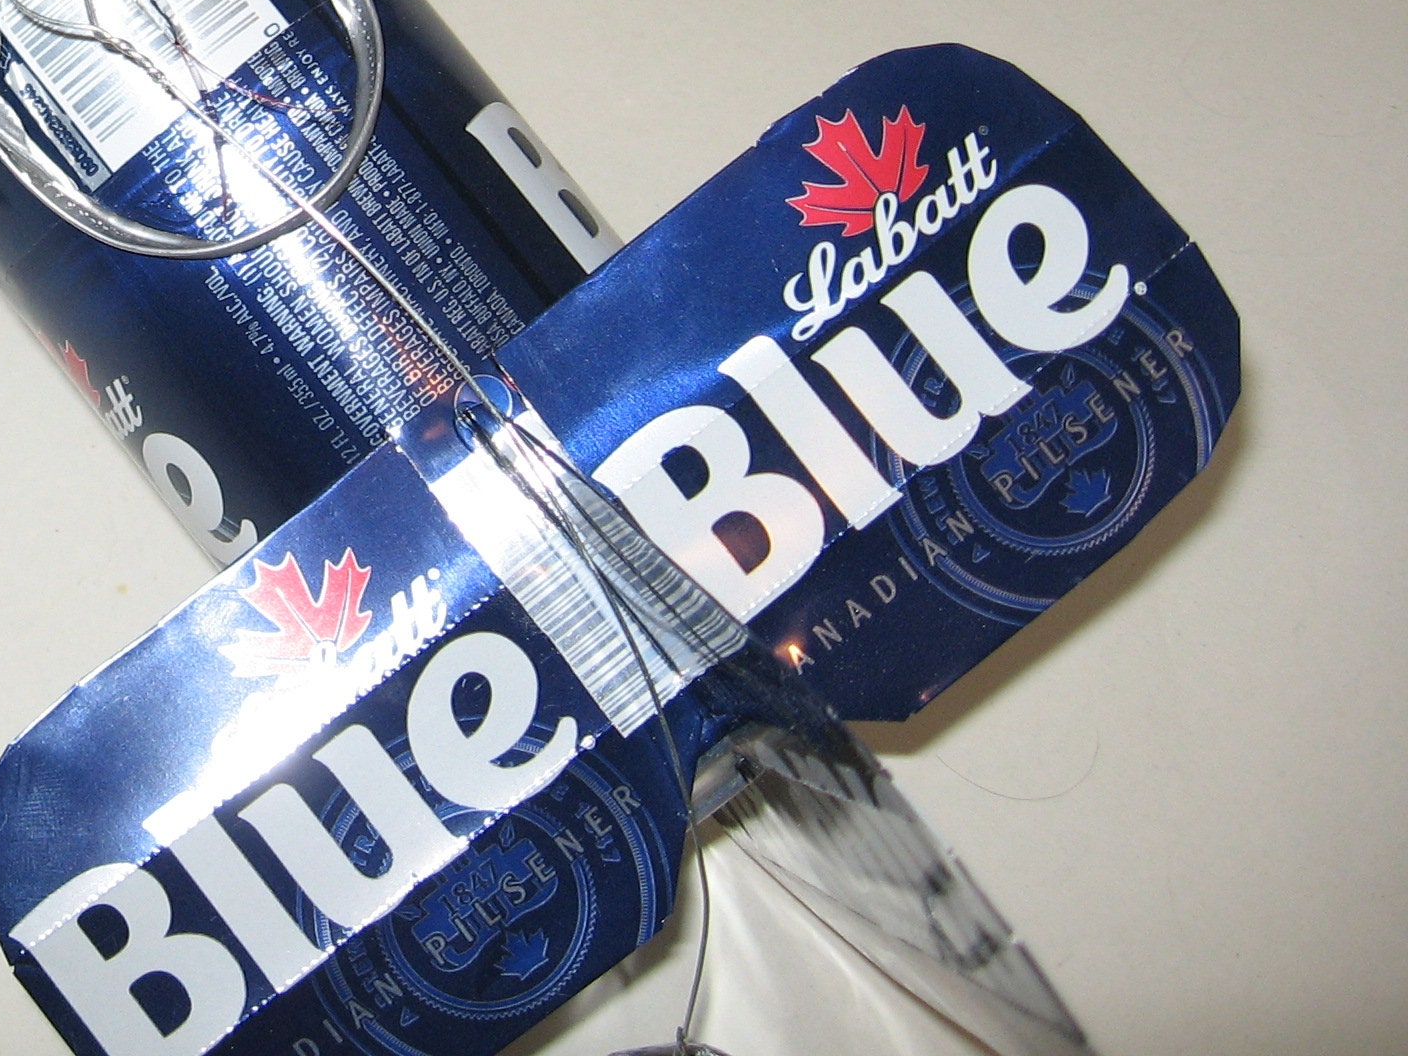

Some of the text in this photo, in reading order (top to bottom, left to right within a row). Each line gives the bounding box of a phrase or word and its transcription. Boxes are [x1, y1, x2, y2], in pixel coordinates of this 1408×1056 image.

[261, 20, 281, 39] 0
[245, 50, 288, 98] IMPORTE
[262, 39, 307, 90] BREWING
[295, 46, 329, 85] ENJOY
[157, 126, 185, 154] AL
[210, 90, 255, 141] DRIVE
[242, 132, 270, 160] TO
[271, 132, 316, 183] CAUSE
[328, 207, 364, 245] AND
[372, 210, 410, 253] LABATT
[384, 194, 417, 229] MADE
[419, 207, 450, 240] INFO:
[782, 131, 997, 342] Labatt
[399, 246, 422, 267] OF
[407, 222, 441, 259] UNION
[140, 139, 387, 447] GOVERNMENT WARNING: (1) TO THE
[200, 264, 253, 326] ALC./VOL.
[248, 243, 298, 299] SHOUL
[333, 246, 391, 314] IMPAIRS
[411, 260, 434, 283] TM
[423, 275, 449, 302] U.S.
[288, 292, 347, 361] WOMEN
[306, 244, 439, 408] OF BIRTH DEFECTS. (2)
[439, 295, 467, 325] REG.
[242, 319, 277, 357] 4.7%
[380, 306, 456, 395] BEVERAGES
[336, 353, 405, 434] GENERAL,
[347, 333, 422, 422] BEVERAGES
[591, 183, 1130, 625] Blue
[325, 425, 349, 449] FL.
[788, 328, 1194, 675] ANADIAN PILSENER
[8, 631, 579, 1056] Blue
[426, 784, 641, 972] PILSENER
